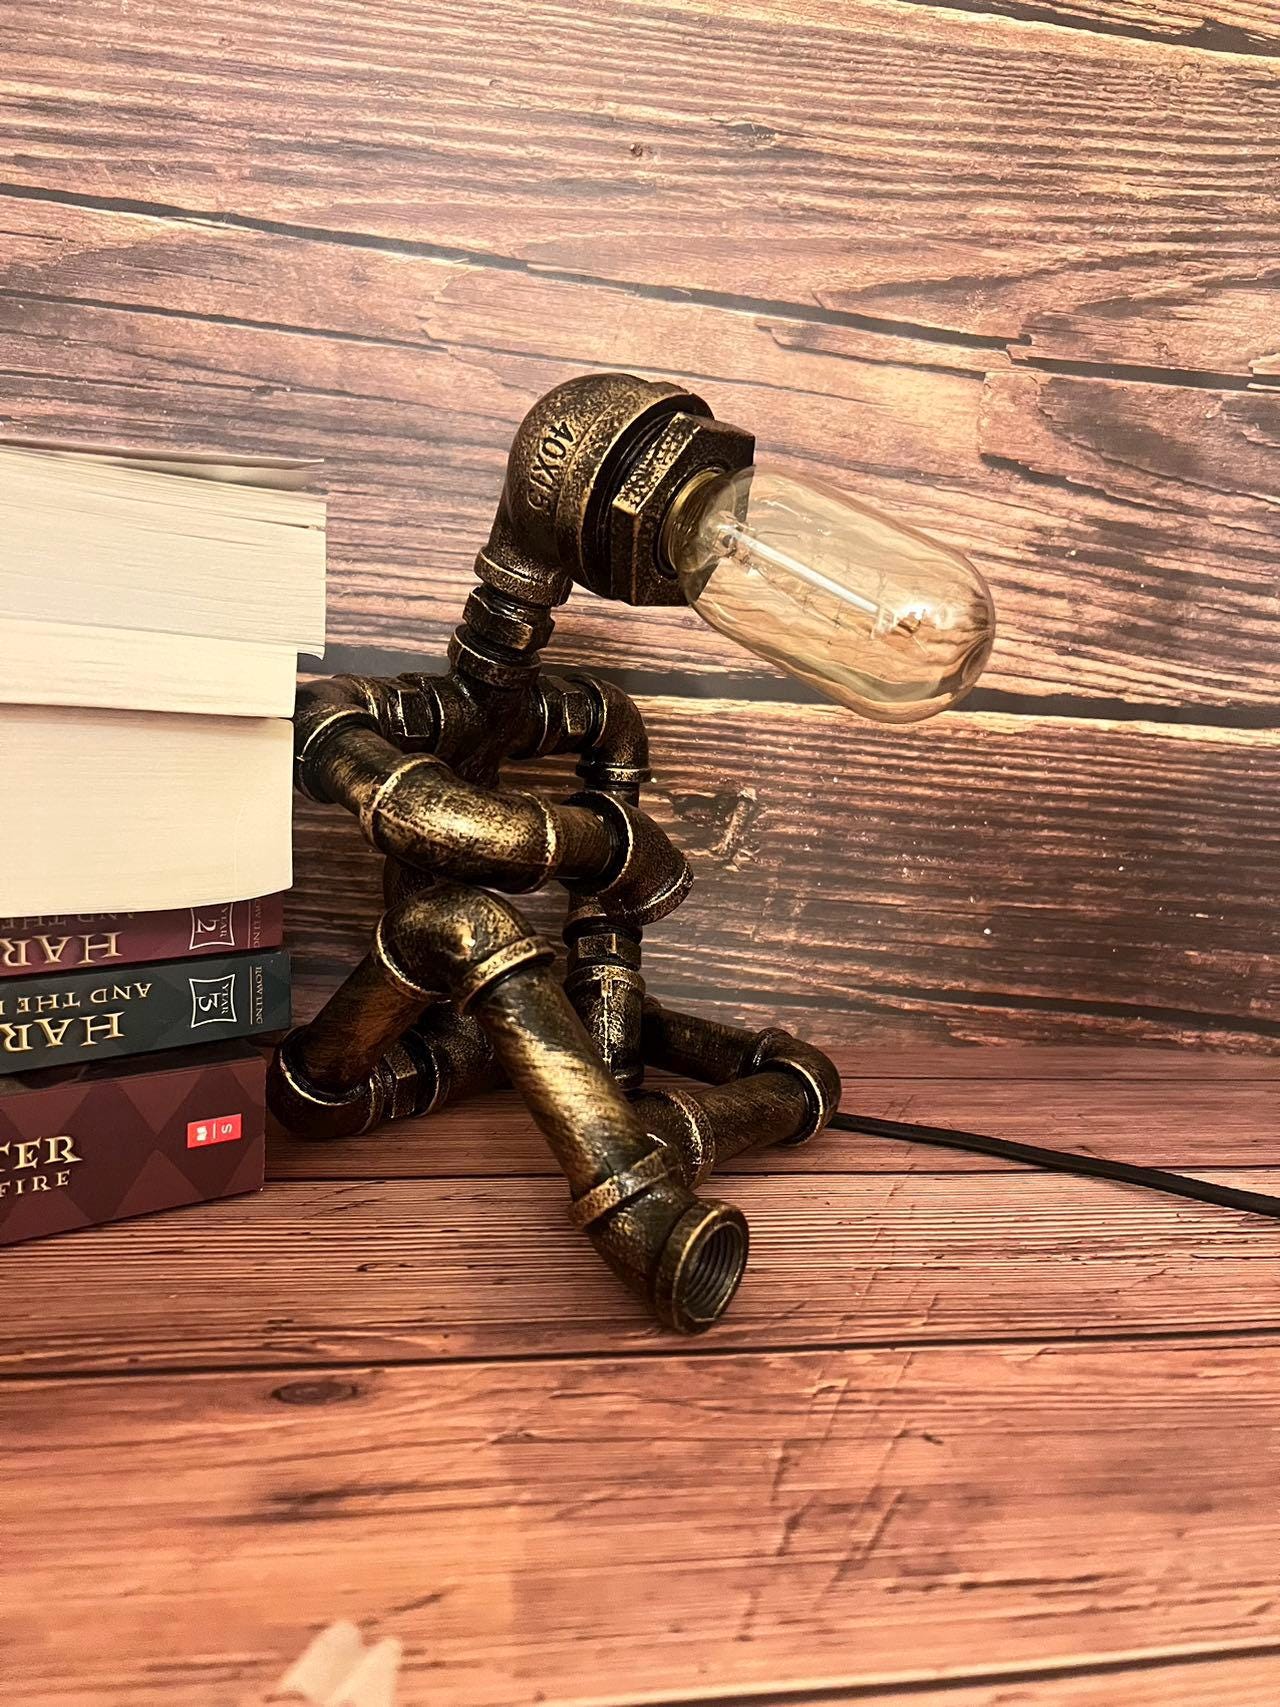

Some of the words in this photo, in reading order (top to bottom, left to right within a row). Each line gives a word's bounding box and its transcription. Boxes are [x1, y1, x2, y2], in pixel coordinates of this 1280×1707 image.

[195, 919, 221, 934] 2
[220, 906, 229, 938] YEAR
[0, 931, 123, 967] HAR
[16, 991, 81, 1014] THE
[90, 982, 152, 1004] AND
[195, 992, 222, 1013] 3
[221, 983, 230, 1015] YEAR
[255, 966, 263, 1025] ROWLING
[0, 1011, 126, 1053] HAR
